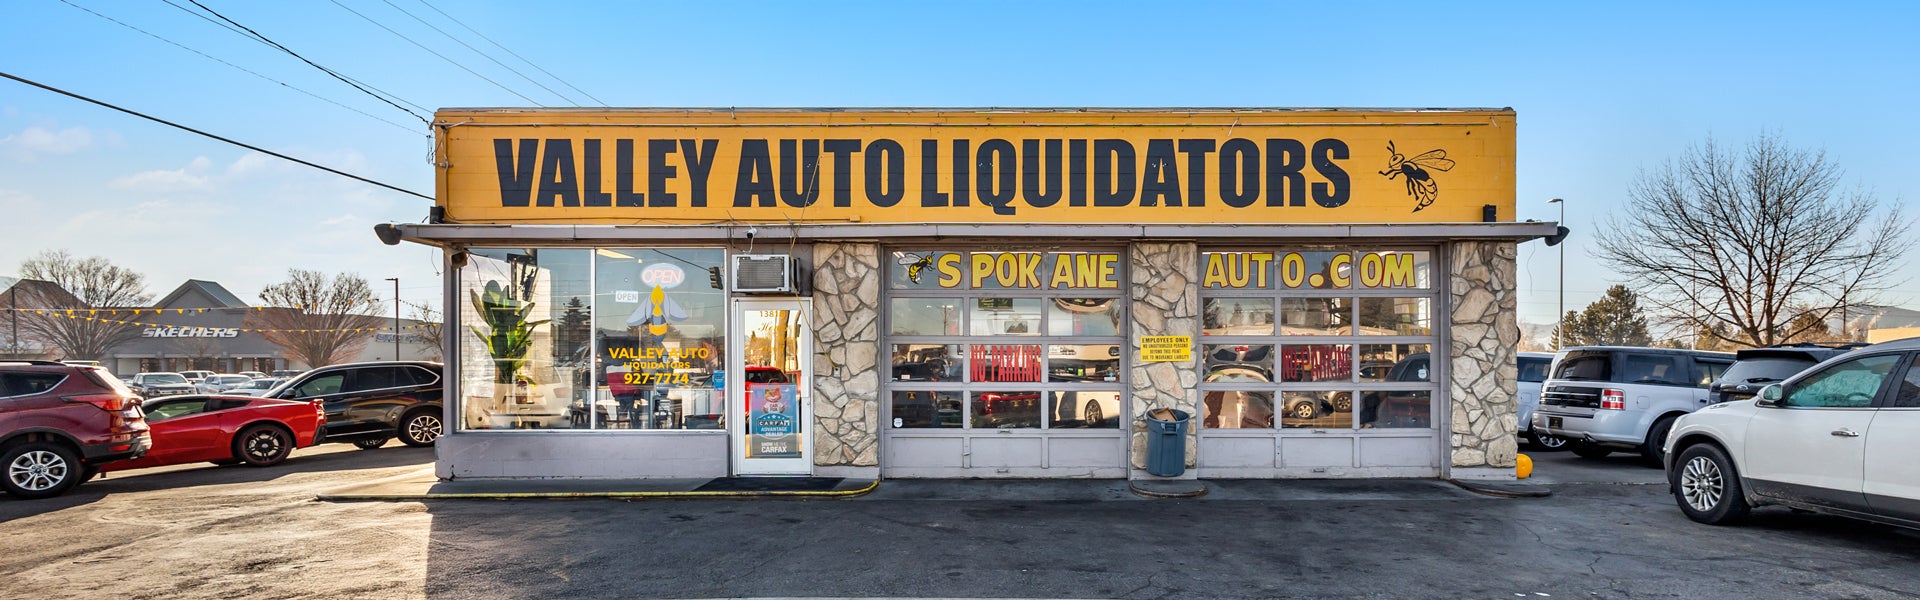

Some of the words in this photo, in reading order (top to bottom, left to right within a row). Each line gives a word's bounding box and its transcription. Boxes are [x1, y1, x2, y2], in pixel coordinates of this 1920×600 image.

[493, 139, 720, 207] VALLEY
[732, 138, 905, 208] AUTO
[920, 137, 1351, 216] LIQUIDATORS
[641, 269, 682, 284] OPEN
[616, 292, 637, 301] OPEN
[141, 327, 240, 338] SKECHERS
[609, 347, 664, 359] VALLEY
[667, 347, 710, 359] AUTO
[623, 361, 691, 370] LIQUIDATORS
[970, 344, 986, 383] NO
[991, 344, 1042, 383] PARKING
[1282, 346, 1298, 383] NO
[623, 372, 690, 385] 927-7774
